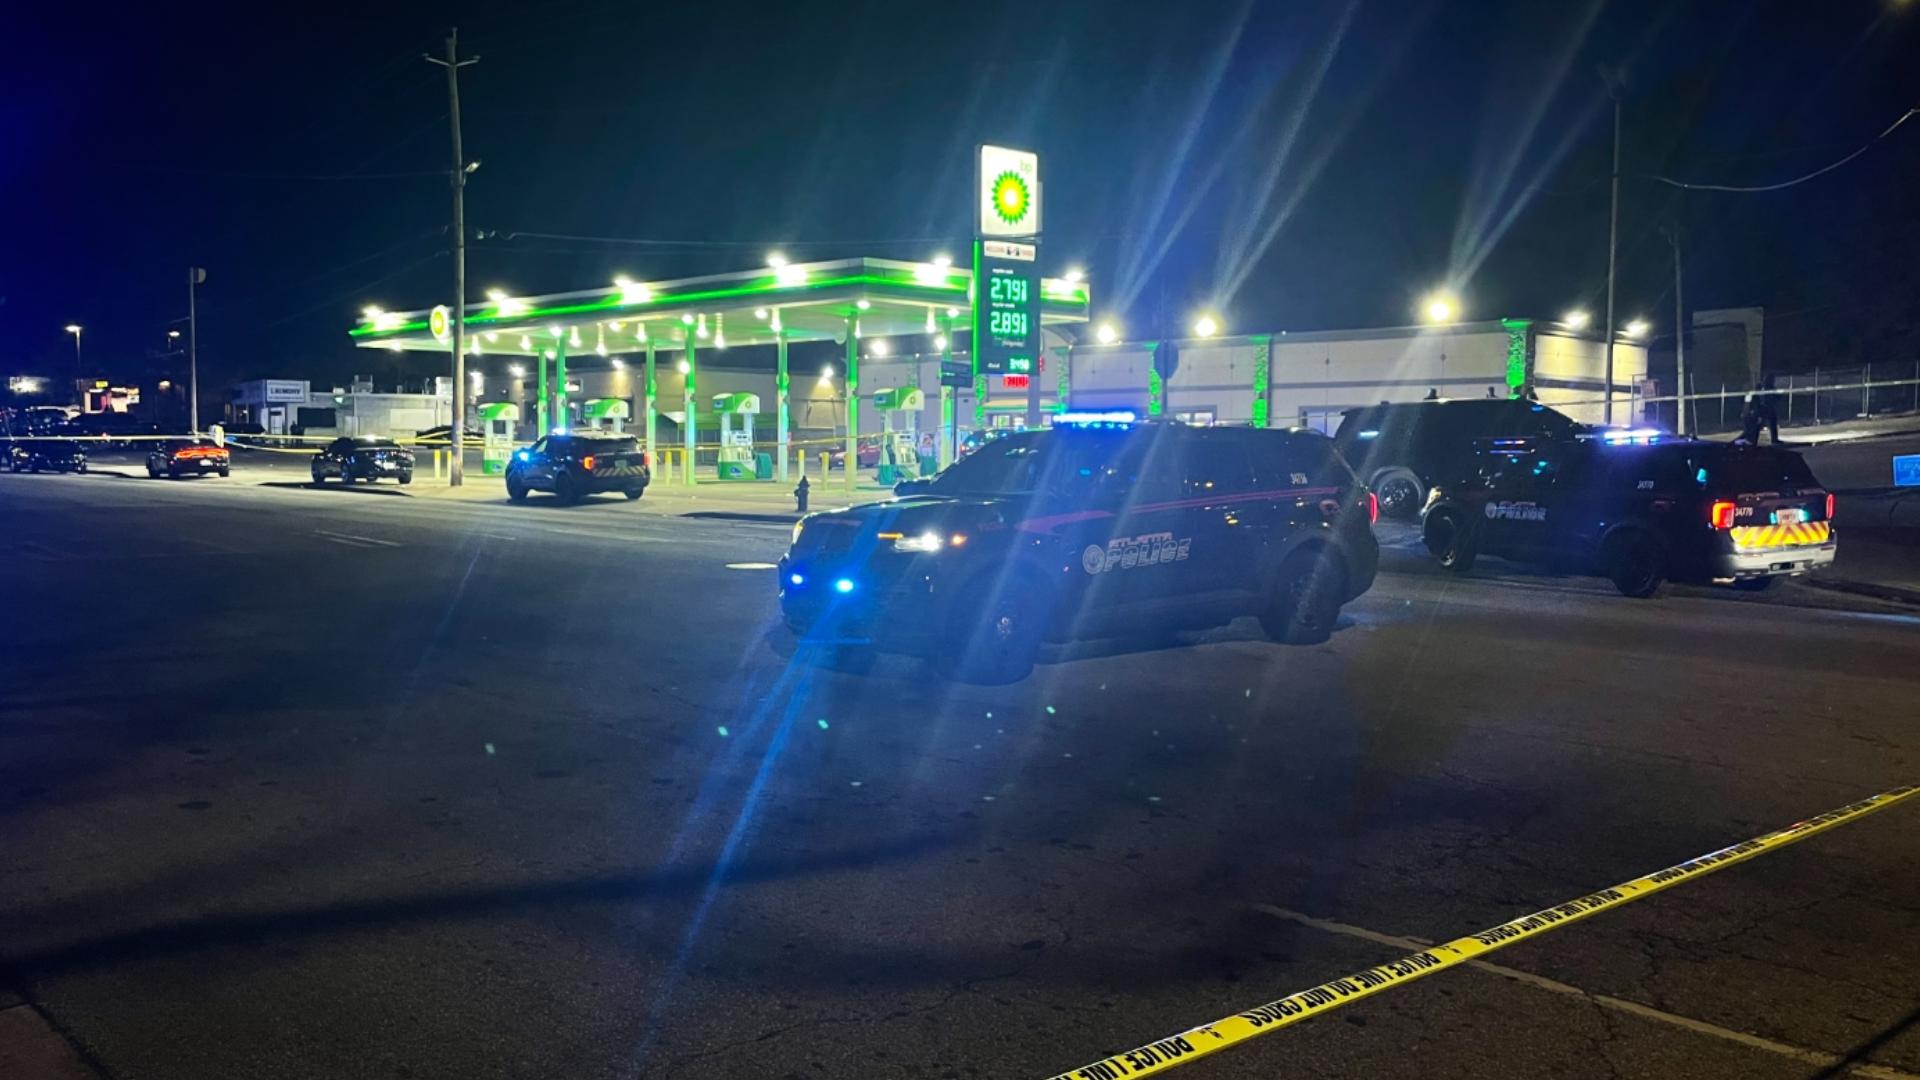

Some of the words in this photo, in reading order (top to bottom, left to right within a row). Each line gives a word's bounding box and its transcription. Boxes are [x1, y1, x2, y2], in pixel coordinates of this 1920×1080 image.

[1104, 538, 1192, 572] POLICE
[1356, 966, 1395, 990] LINE
[1389, 952, 1442, 978] POLICE
[1301, 985, 1338, 1009] NOT
[1237, 998, 1304, 1027] CROSS
[1125, 1036, 1195, 1072] POLICE
